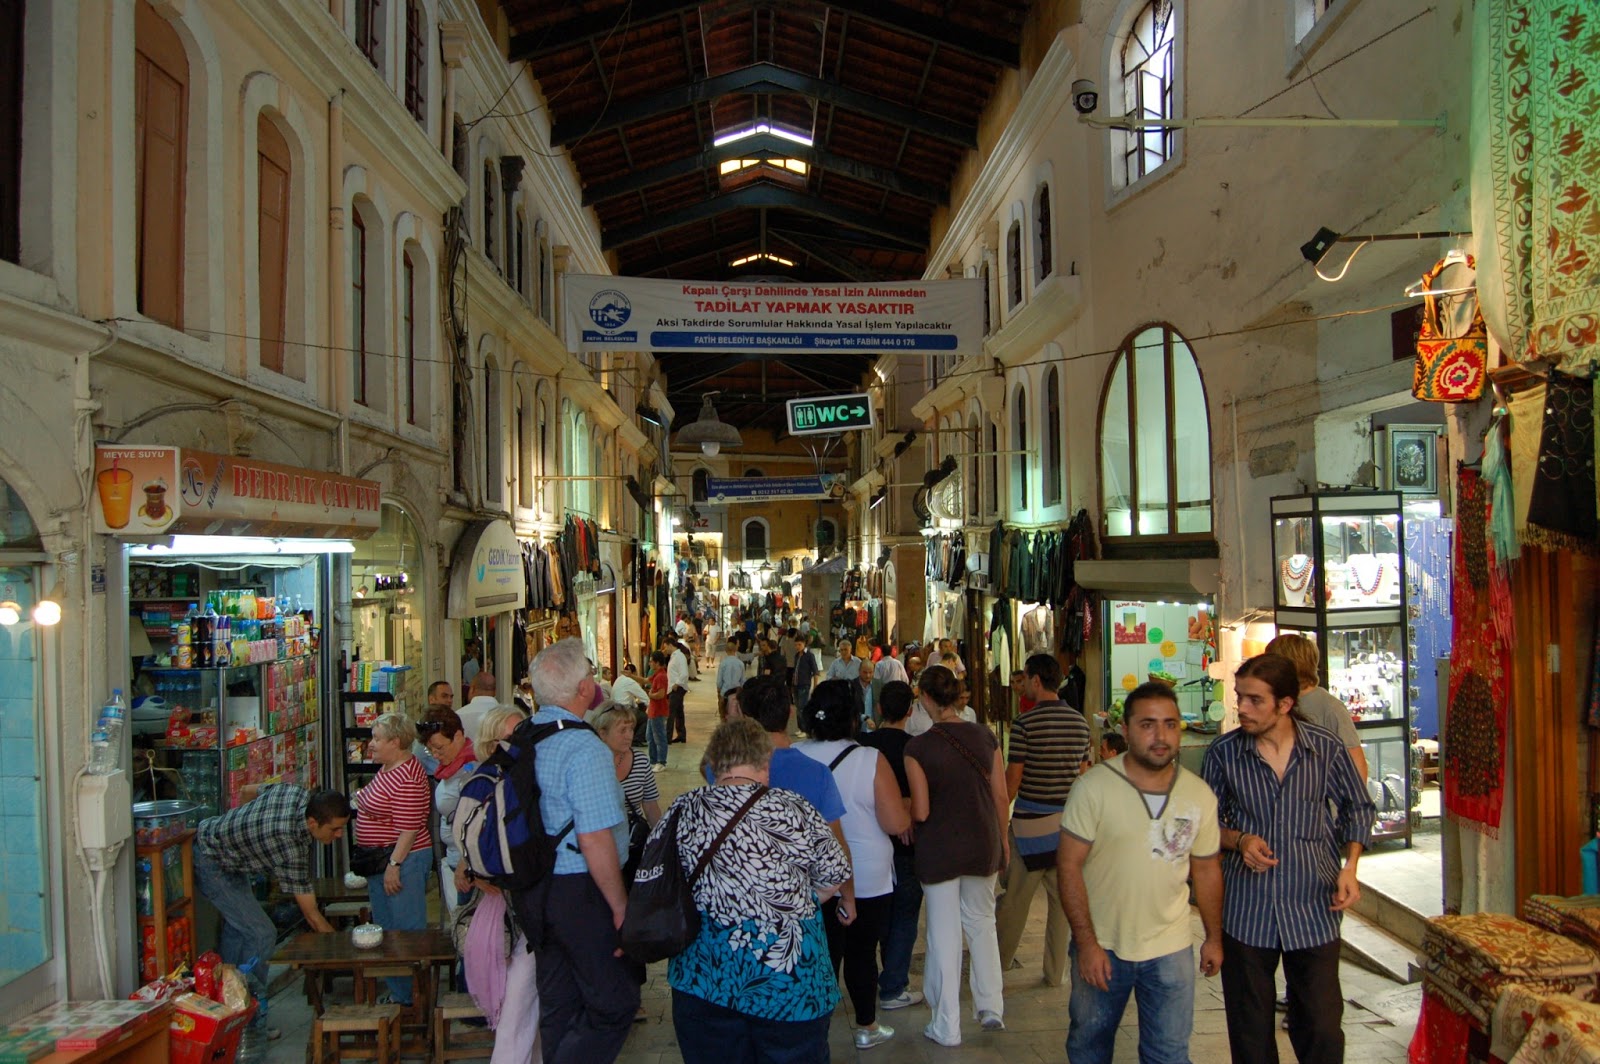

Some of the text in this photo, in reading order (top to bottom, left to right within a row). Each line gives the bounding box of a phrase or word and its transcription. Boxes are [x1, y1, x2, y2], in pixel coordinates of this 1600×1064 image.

[682, 285, 927, 298] Kapalı Çarşı Dahilinde Yasal İzin Alınmadan
[694, 298, 915, 315] TADİLAT YAPMAK YASAKTIR
[656, 318, 952, 331] Aksi Takdirde Sorumlular Hakkında Yasal İşlem Yapılacaktır
[694, 335, 915, 347] FATİH BELEDİYE BAŞKANLIĞI Şikayet Tel: FABİM 444 0 176
[816, 405, 849, 423] WC
[103, 451, 136, 459] MEYVE
[232, 465, 316, 505] BERRAK
[321, 475, 351, 513] ÇAY
[355, 481, 382, 512] EVİ
